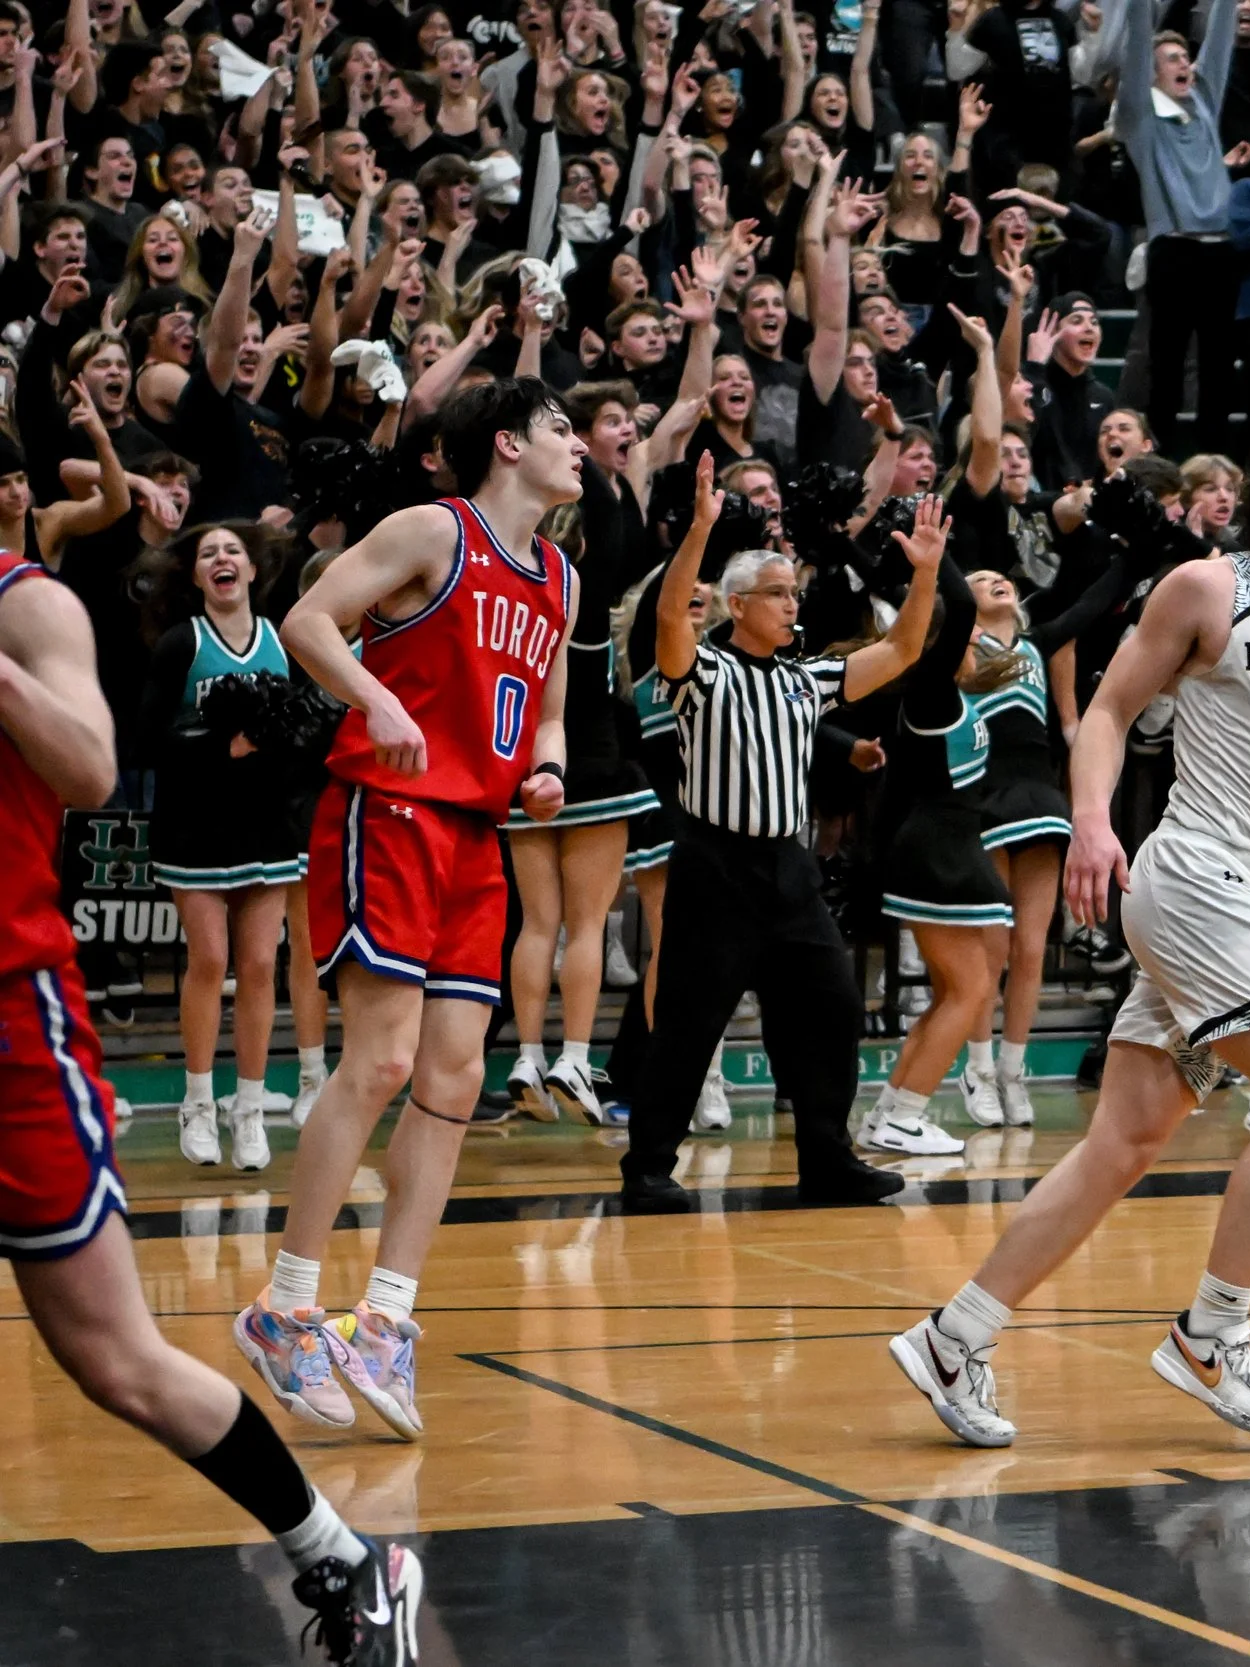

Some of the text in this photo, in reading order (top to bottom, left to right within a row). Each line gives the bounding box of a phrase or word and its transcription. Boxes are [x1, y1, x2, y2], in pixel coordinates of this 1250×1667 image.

[473, 591, 559, 679] TOROS
[492, 673, 528, 761] 0
[72, 899, 187, 944] STUD
